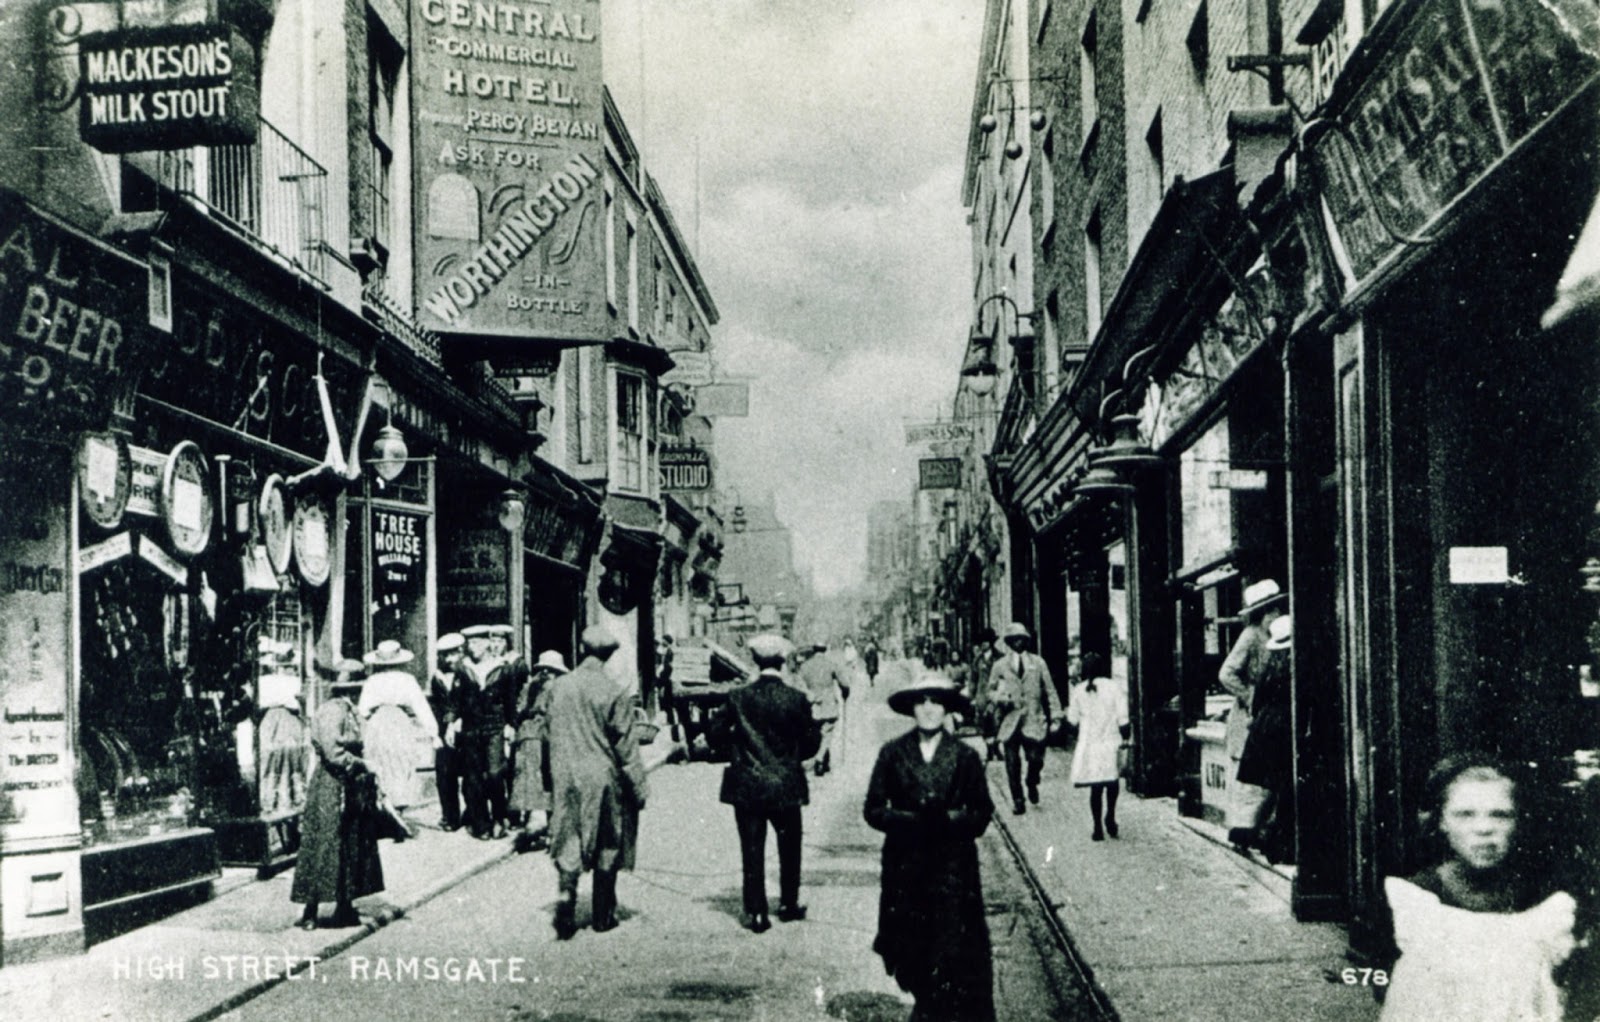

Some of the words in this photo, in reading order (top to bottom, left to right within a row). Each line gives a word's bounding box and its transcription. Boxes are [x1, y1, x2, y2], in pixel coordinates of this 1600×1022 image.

[422, 0, 596, 42] CENTRAL
[88, 37, 232, 84] MACKESON'S
[445, 36, 577, 70] COMMERCIAL
[464, 109, 528, 134] PERCY
[531, 115, 599, 139] BEVAN
[439, 141, 486, 165] ASK
[494, 149, 542, 171] FOR
[424, 153, 601, 326] WORTHINGTON
[507, 294, 583, 315] BOTTLE
[16, 283, 122, 375] BEER
[660, 465, 709, 488] STUDIO
[379, 513, 417, 535] FREE
[375, 531, 420, 556] HOUSE
